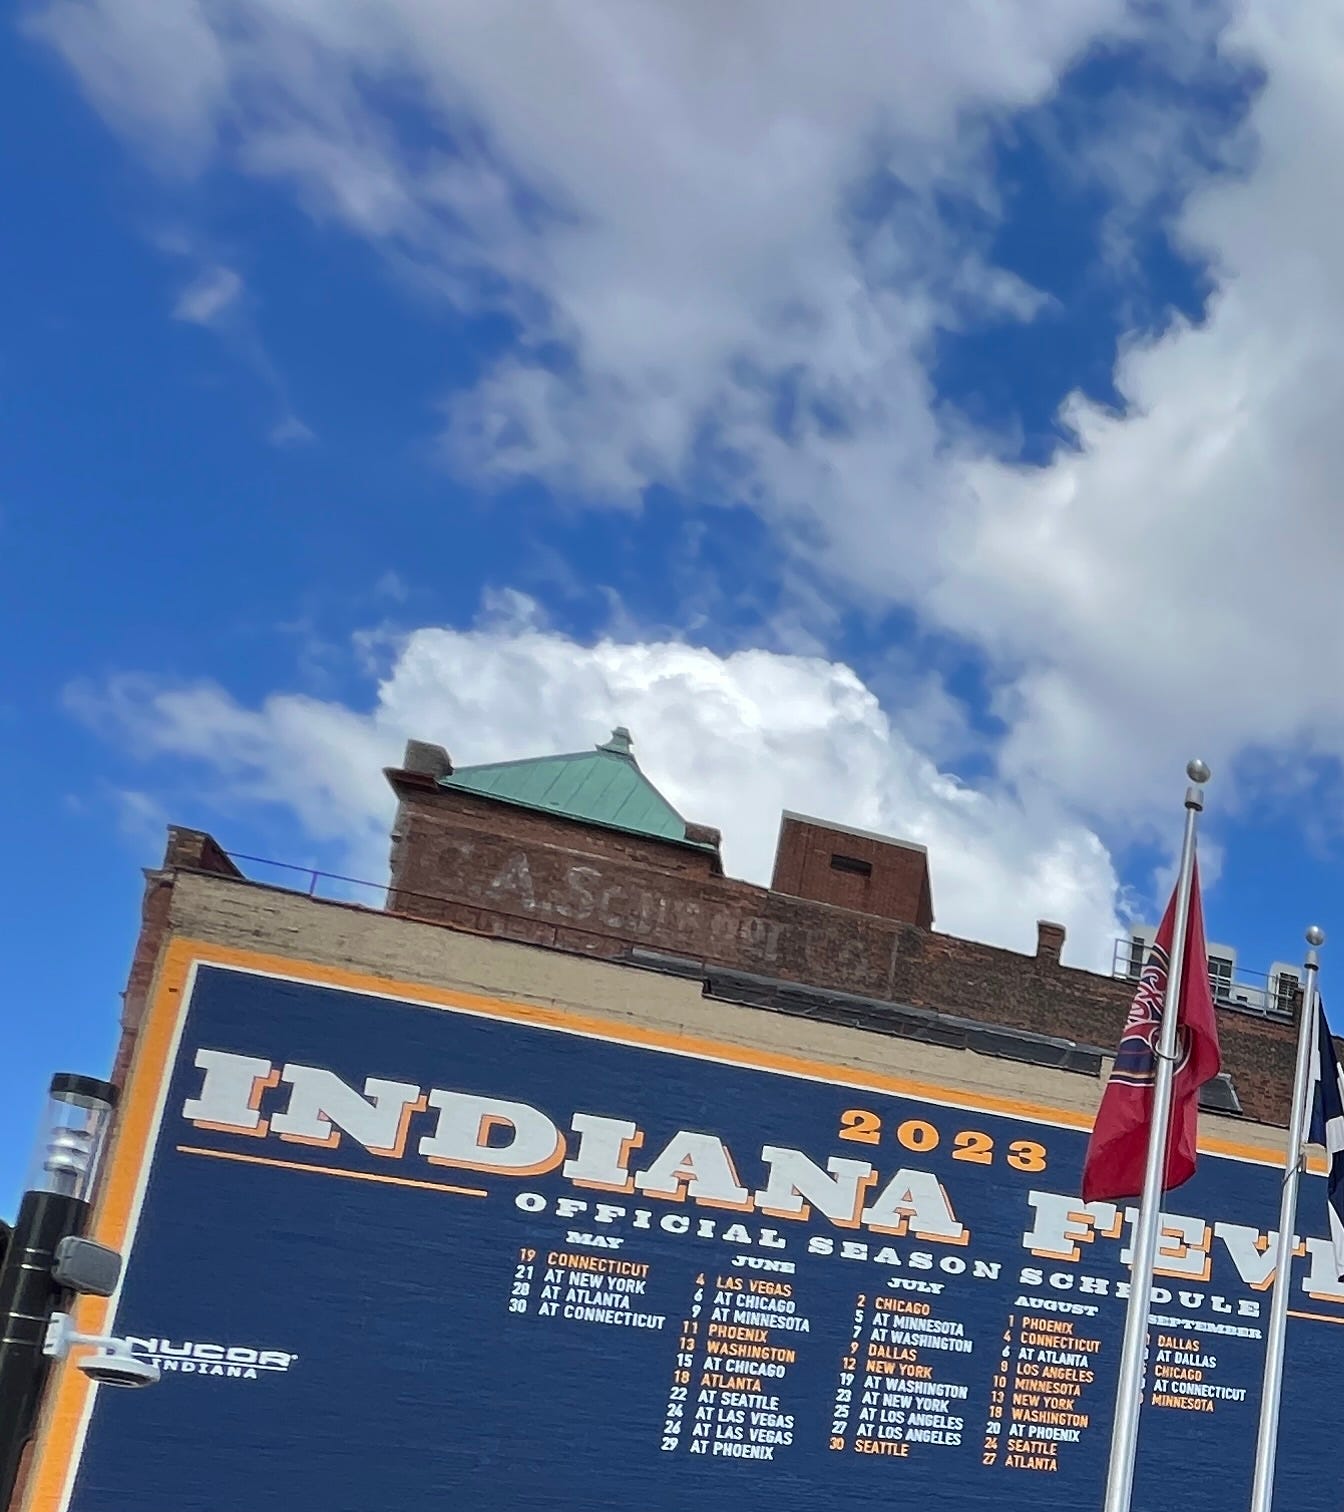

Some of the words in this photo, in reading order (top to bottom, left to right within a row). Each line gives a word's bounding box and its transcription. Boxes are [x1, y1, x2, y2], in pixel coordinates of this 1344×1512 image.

[183, 1048, 970, 1246] INDIANA
[838, 1109, 1047, 1172] 2023
[566, 1231, 624, 1249] MAY
[515, 1192, 786, 1248] OFFICIAL
[808, 1237, 1001, 1279] SEASON
[1019, 1267, 1260, 1318] SCHEDULE
[519, 1248, 536, 1262] 19
[547, 1252, 649, 1277] CONNECTICUT
[731, 1256, 796, 1274] JUNE
[515, 1265, 533, 1280] 21
[543, 1269, 565, 1284] AT
[569, 1272, 602, 1288] NEW
[606, 1276, 646, 1294] YORK
[695, 1273, 705, 1286] 4
[716, 1276, 743, 1290] LAS
[750, 1279, 792, 1296] VEGAS
[887, 1277, 945, 1295] JULY
[512, 1281, 530, 1296] 28
[541, 1285, 562, 1300] AT
[566, 1288, 630, 1309] ATLANTA
[694, 1289, 703, 1301] 6
[714, 1292, 732, 1306] AT
[736, 1294, 796, 1313] CHICAGO
[857, 1294, 866, 1307] 2
[875, 1297, 930, 1316] CHICAGO
[1014, 1296, 1099, 1317] AUGUST
[509, 1298, 527, 1313] 30
[538, 1302, 560, 1317] AT
[564, 1305, 666, 1329] CONNECTICUT
[692, 1305, 701, 1318] 9
[711, 1308, 731, 1322] AT
[734, 1310, 810, 1332] MINNESOTA
[854, 1309, 864, 1323] 5
[872, 1312, 891, 1326] AT
[893, 1315, 964, 1337] MINNESOTA
[1008, 1315, 1014, 1327] 1
[1022, 1316, 1074, 1335] PHOENIX
[682, 1320, 698, 1334] 11
[709, 1324, 769, 1343] PHOENIX
[1148, 1314, 1262, 1339] SEPTEMBER
[680, 1337, 695, 1350] 13
[707, 1341, 796, 1363] WASHINGTON
[852, 1325, 862, 1338] 7
[870, 1328, 888, 1342] AT
[890, 1331, 973, 1353] WASHINGTON
[1003, 1330, 1011, 1342] 4
[1020, 1332, 1101, 1353] CONNECTICUT
[1158, 1334, 1200, 1351] DALLAS
[850, 1341, 860, 1354] 9
[868, 1343, 917, 1362] DALLAS
[1002, 1345, 1010, 1358] 6
[1018, 1348, 1035, 1360] AT
[1037, 1350, 1089, 1368] ATLANTA
[1156, 1350, 1171, 1363] AT
[1174, 1352, 1217, 1369] DALLAS
[152, 1358, 258, 1379] INDIANA
[677, 1354, 693, 1367] 15
[703, 1356, 722, 1371] AT
[726, 1359, 786, 1378] CHICAGO
[843, 1357, 856, 1370] 12
[866, 1360, 896, 1374] NEW
[899, 1363, 933, 1379] YORK
[1000, 1360, 1008, 1373] 8
[1016, 1362, 1039, 1376] LOS
[1042, 1365, 1094, 1383] ANGELES
[1155, 1365, 1202, 1381] CHICAGO
[674, 1370, 690, 1384] 18
[700, 1373, 762, 1392] ATLANTA
[839, 1372, 855, 1386] 19
[864, 1375, 882, 1389] AT
[885, 1378, 968, 1400] WASHINGTON
[993, 1375, 1007, 1388] 10
[1014, 1378, 1081, 1397] MINNESOTA
[1153, 1380, 1169, 1393] AT
[1171, 1382, 1247, 1401] CONNECTICUT
[669, 1386, 688, 1401] 22
[698, 1389, 717, 1404] AT
[720, 1392, 780, 1411] SEATTLE
[835, 1388, 852, 1402] 23
[861, 1391, 880, 1405] AT
[883, 1394, 913, 1409] NEW
[915, 1397, 950, 1413] YORK
[991, 1391, 1004, 1404] 13
[1012, 1393, 1041, 1408] NEW
[1043, 1396, 1075, 1411] YORK
[1152, 1393, 1214, 1412] MINNESOTA
[666, 1403, 683, 1418] 24
[695, 1406, 715, 1420] AT
[717, 1408, 745, 1424] LAS
[751, 1412, 795, 1429] VEGAS
[833, 1404, 851, 1418] 25
[859, 1407, 878, 1421] AT
[880, 1410, 905, 1424] LOS
[907, 1413, 964, 1430] ANGELES
[989, 1406, 1002, 1419] 18
[1011, 1408, 1089, 1428] WASHINGTON
[664, 1420, 681, 1434] 26
[692, 1423, 711, 1437] AT
[715, 1425, 743, 1441] LAS
[749, 1429, 793, 1446] VEGAS
[831, 1420, 847, 1434] 27
[856, 1423, 875, 1437] AT
[877, 1425, 902, 1440] LOS
[905, 1428, 962, 1446] ANGELES
[986, 1421, 1001, 1435] 20
[1009, 1423, 1027, 1437] AT
[1028, 1426, 1081, 1443] PHOENIX
[660, 1437, 678, 1451] 29
[690, 1439, 710, 1454] AT
[712, 1442, 774, 1460] PHOENIX
[829, 1437, 845, 1450] 30
[854, 1440, 910, 1457] SEATTLE
[983, 1437, 998, 1450] 24
[1007, 1439, 1058, 1456] SEATTLE
[982, 1452, 997, 1466] 27
[1005, 1454, 1058, 1471] ATLANTA
